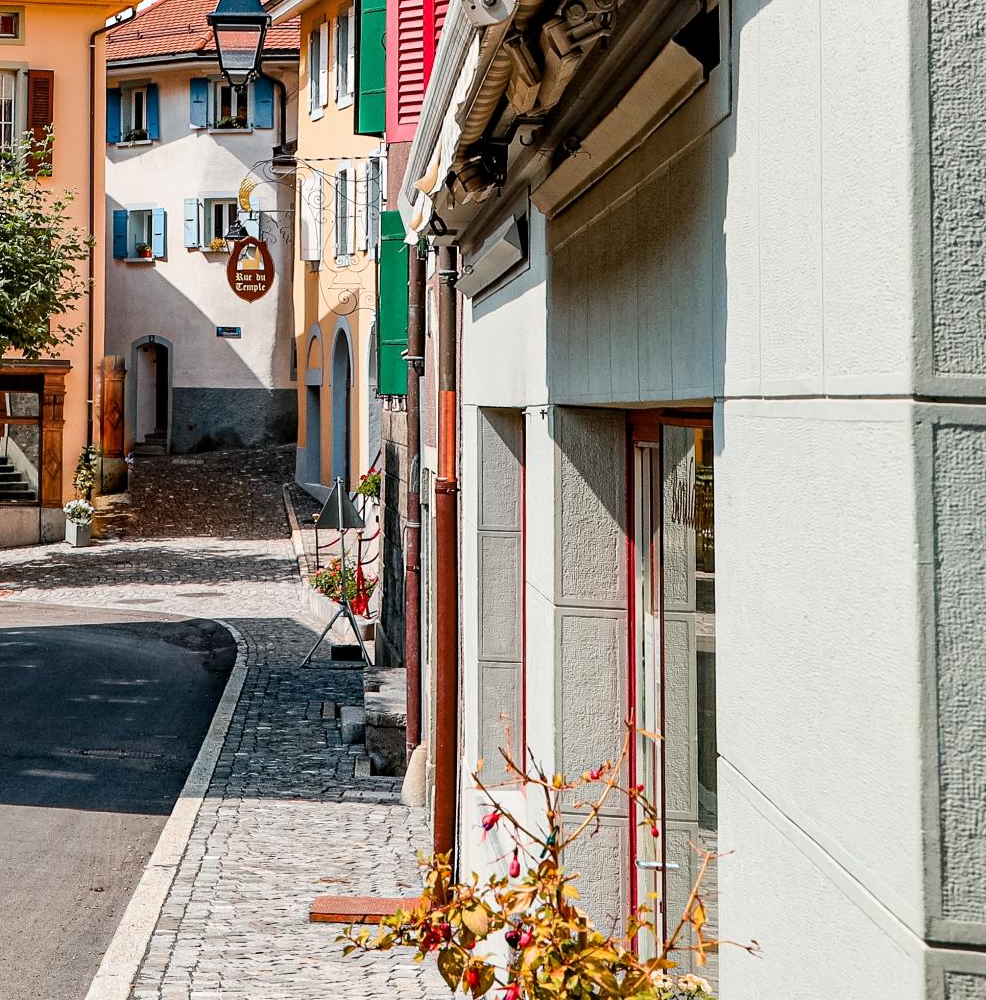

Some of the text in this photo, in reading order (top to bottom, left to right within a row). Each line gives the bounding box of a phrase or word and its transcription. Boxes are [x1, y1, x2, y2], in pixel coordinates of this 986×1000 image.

[235, 272, 266, 282] Rue du
[235, 282, 266, 293] Temple
